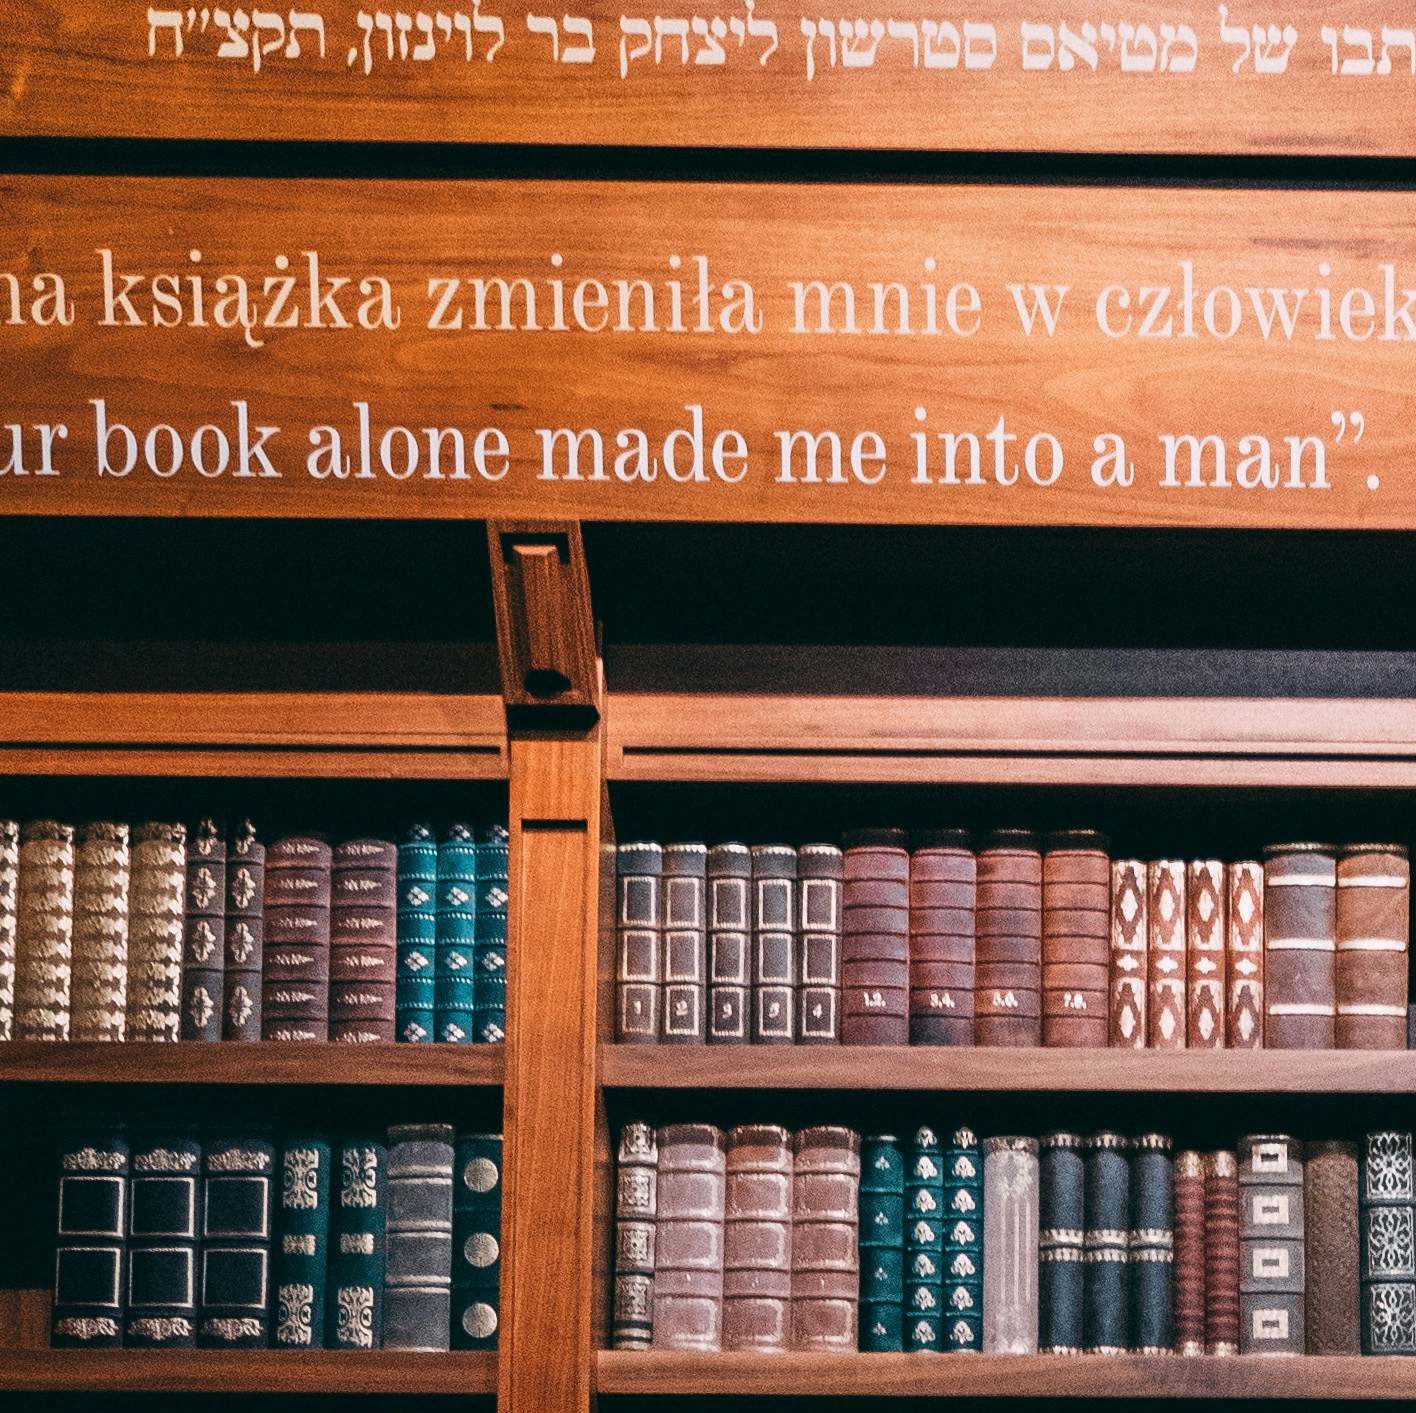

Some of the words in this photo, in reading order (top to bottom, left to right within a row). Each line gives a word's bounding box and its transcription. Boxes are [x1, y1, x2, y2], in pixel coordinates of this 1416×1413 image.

[346, 0, 506, 77] לוינזון,
[525, 12, 597, 66] בר
[618, 0, 779, 80] ליצחק
[800, 17, 998, 82] סטרשון
[1020, 20, 1199, 73] מטיאס
[1218, 6, 1299, 75] של
[96, 248, 402, 349] książka
[426, 252, 764, 335] zmieniła
[787, 256, 982, 337] mnie
[1006, 284, 1070, 337] w
[88, 398, 283, 478] book
[306, 400, 511, 482] alone
[534, 403, 749, 484] made
[773, 429, 887, 485] me
[910, 406, 1064, 486] into
[1090, 433, 1135, 488] a
[1158, 410, 1380, 491] man”.
